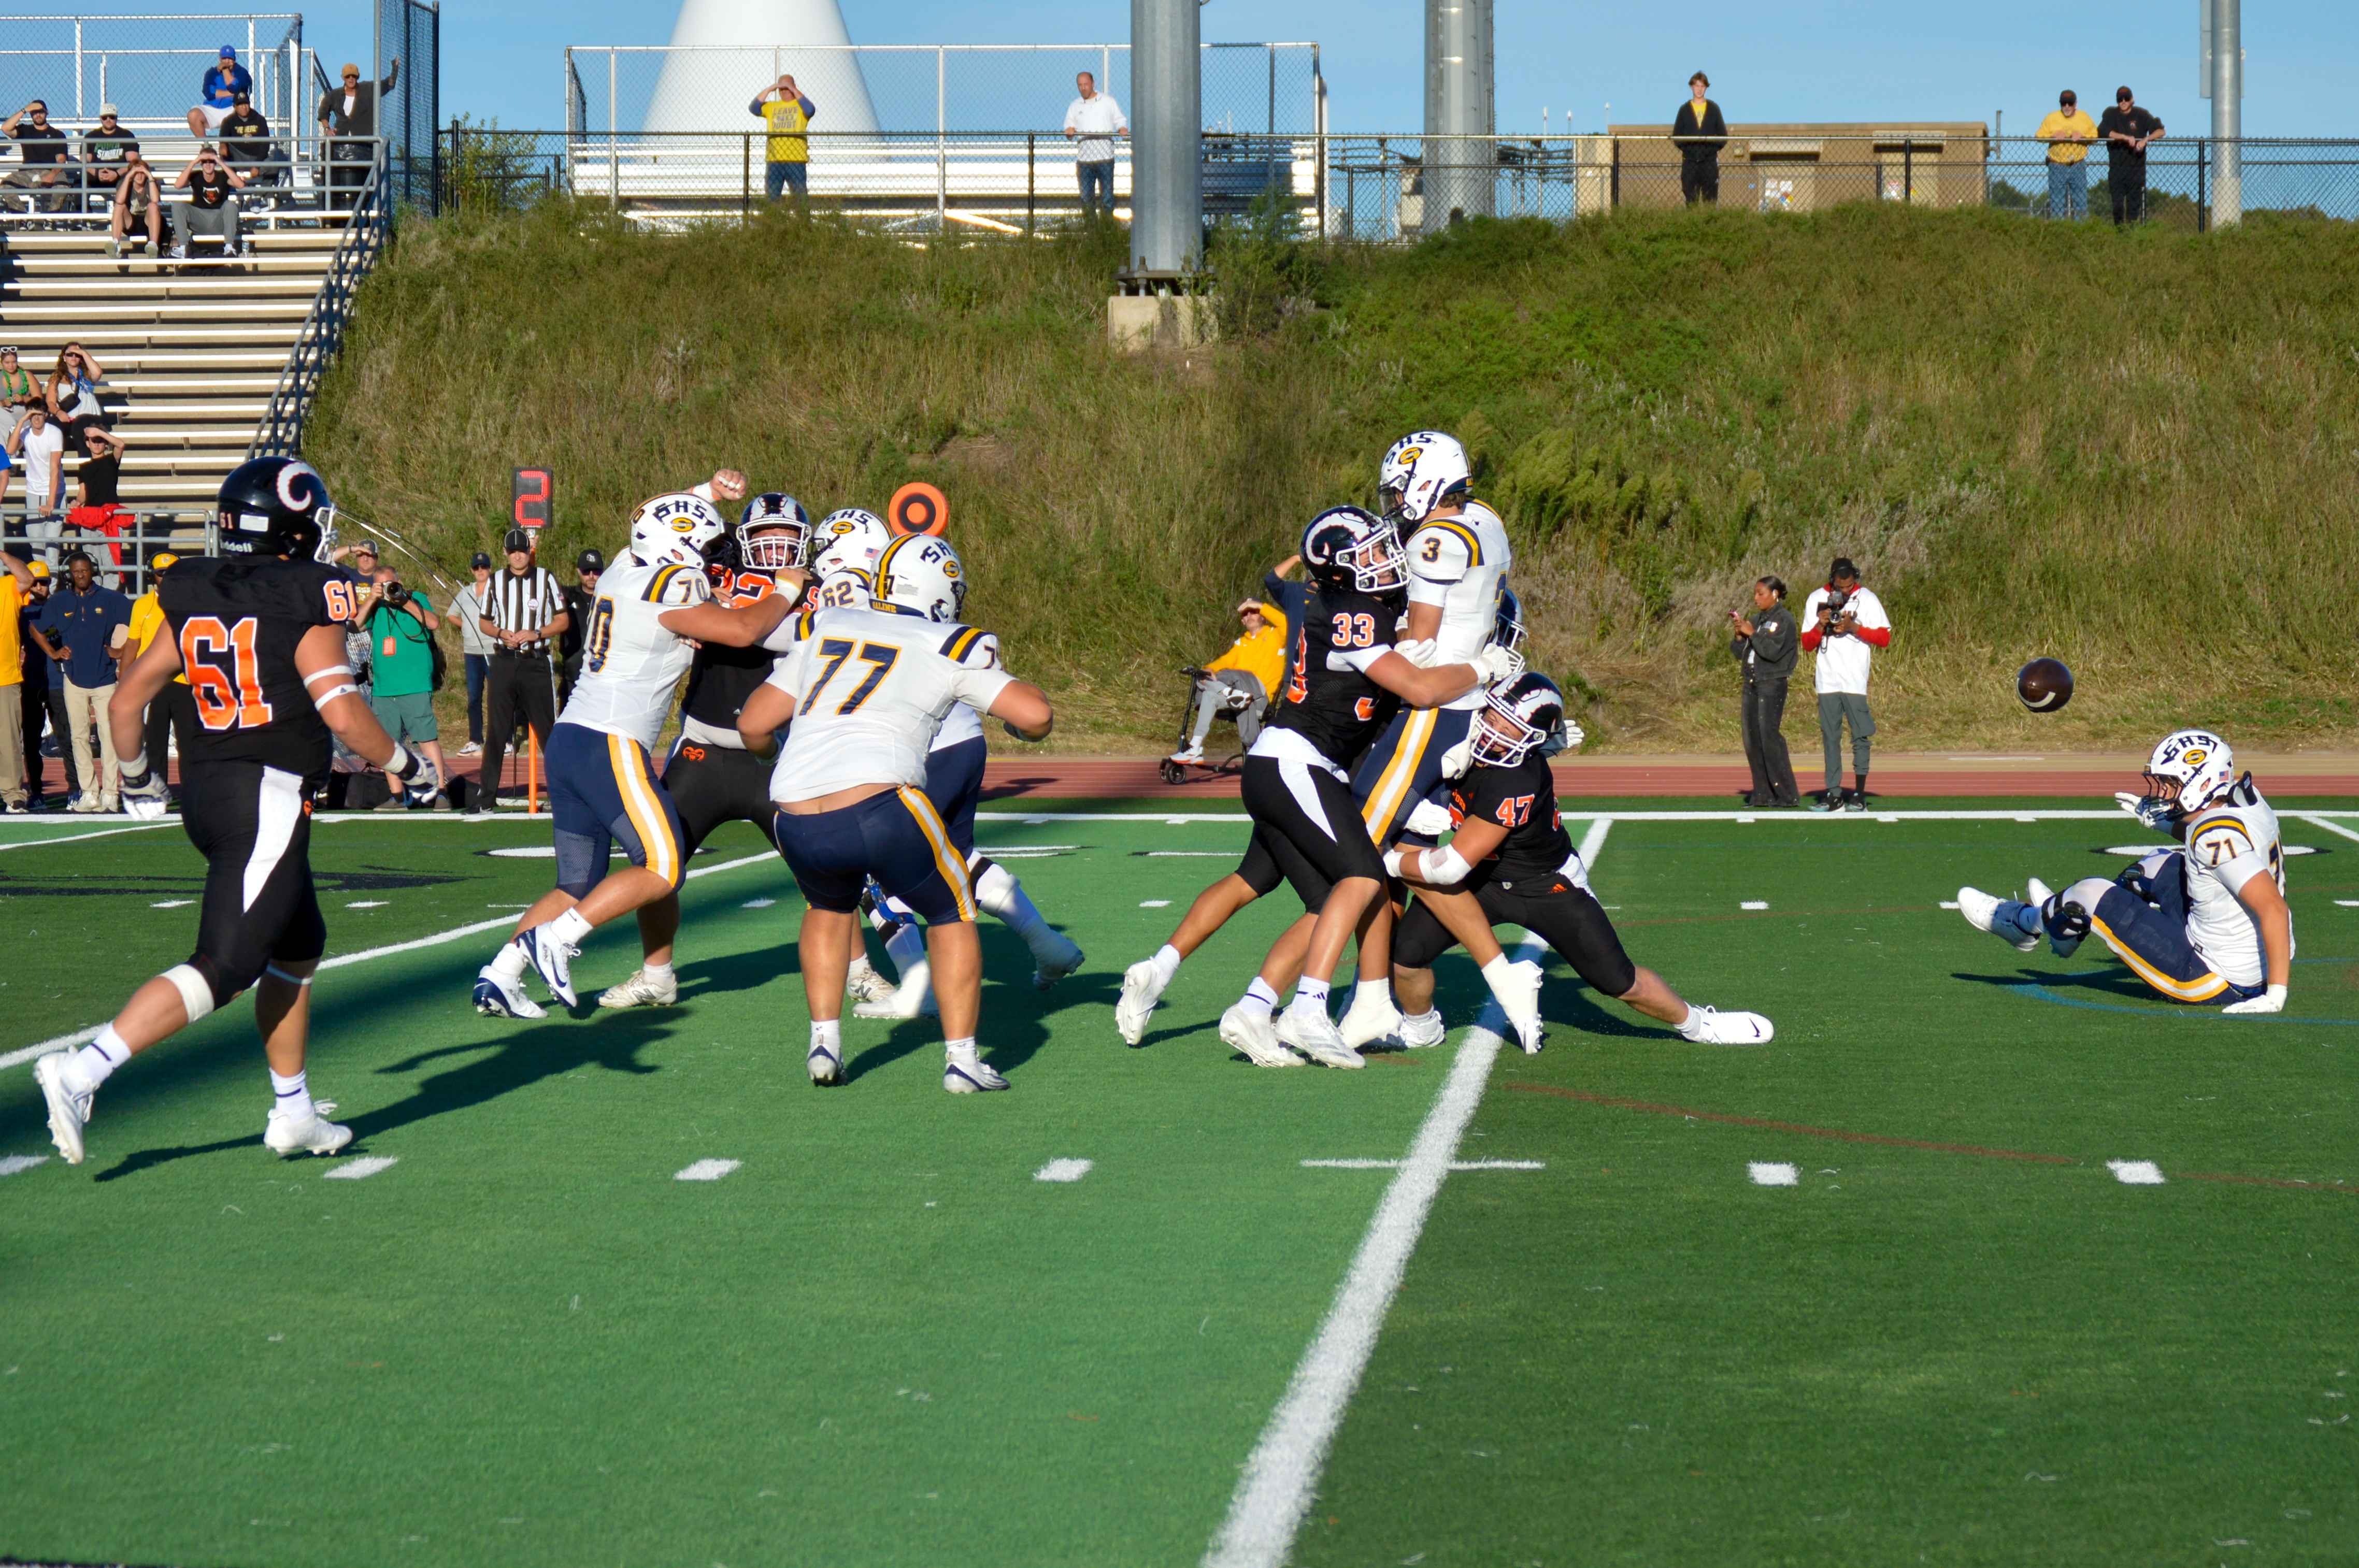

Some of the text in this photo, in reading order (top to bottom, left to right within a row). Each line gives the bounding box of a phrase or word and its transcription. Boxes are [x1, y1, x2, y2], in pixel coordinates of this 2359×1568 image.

[773, 107, 798, 115] LEAVE
[773, 121, 796, 129] DOUBT
[514, 470, 550, 526] 2
[220, 512, 233, 529] 61
[220, 539, 253, 553] iddell
[1422, 537, 1441, 563] 3
[677, 578, 708, 604] 70
[822, 581, 854, 608] 62
[872, 571, 895, 596] 77
[323, 580, 358, 621] 61
[1332, 613, 1375, 647] 33
[180, 616, 273, 730] 61
[798, 637, 901, 716] 77
[1496, 794, 1535, 827] 47
[2205, 837, 2238, 866] 71
